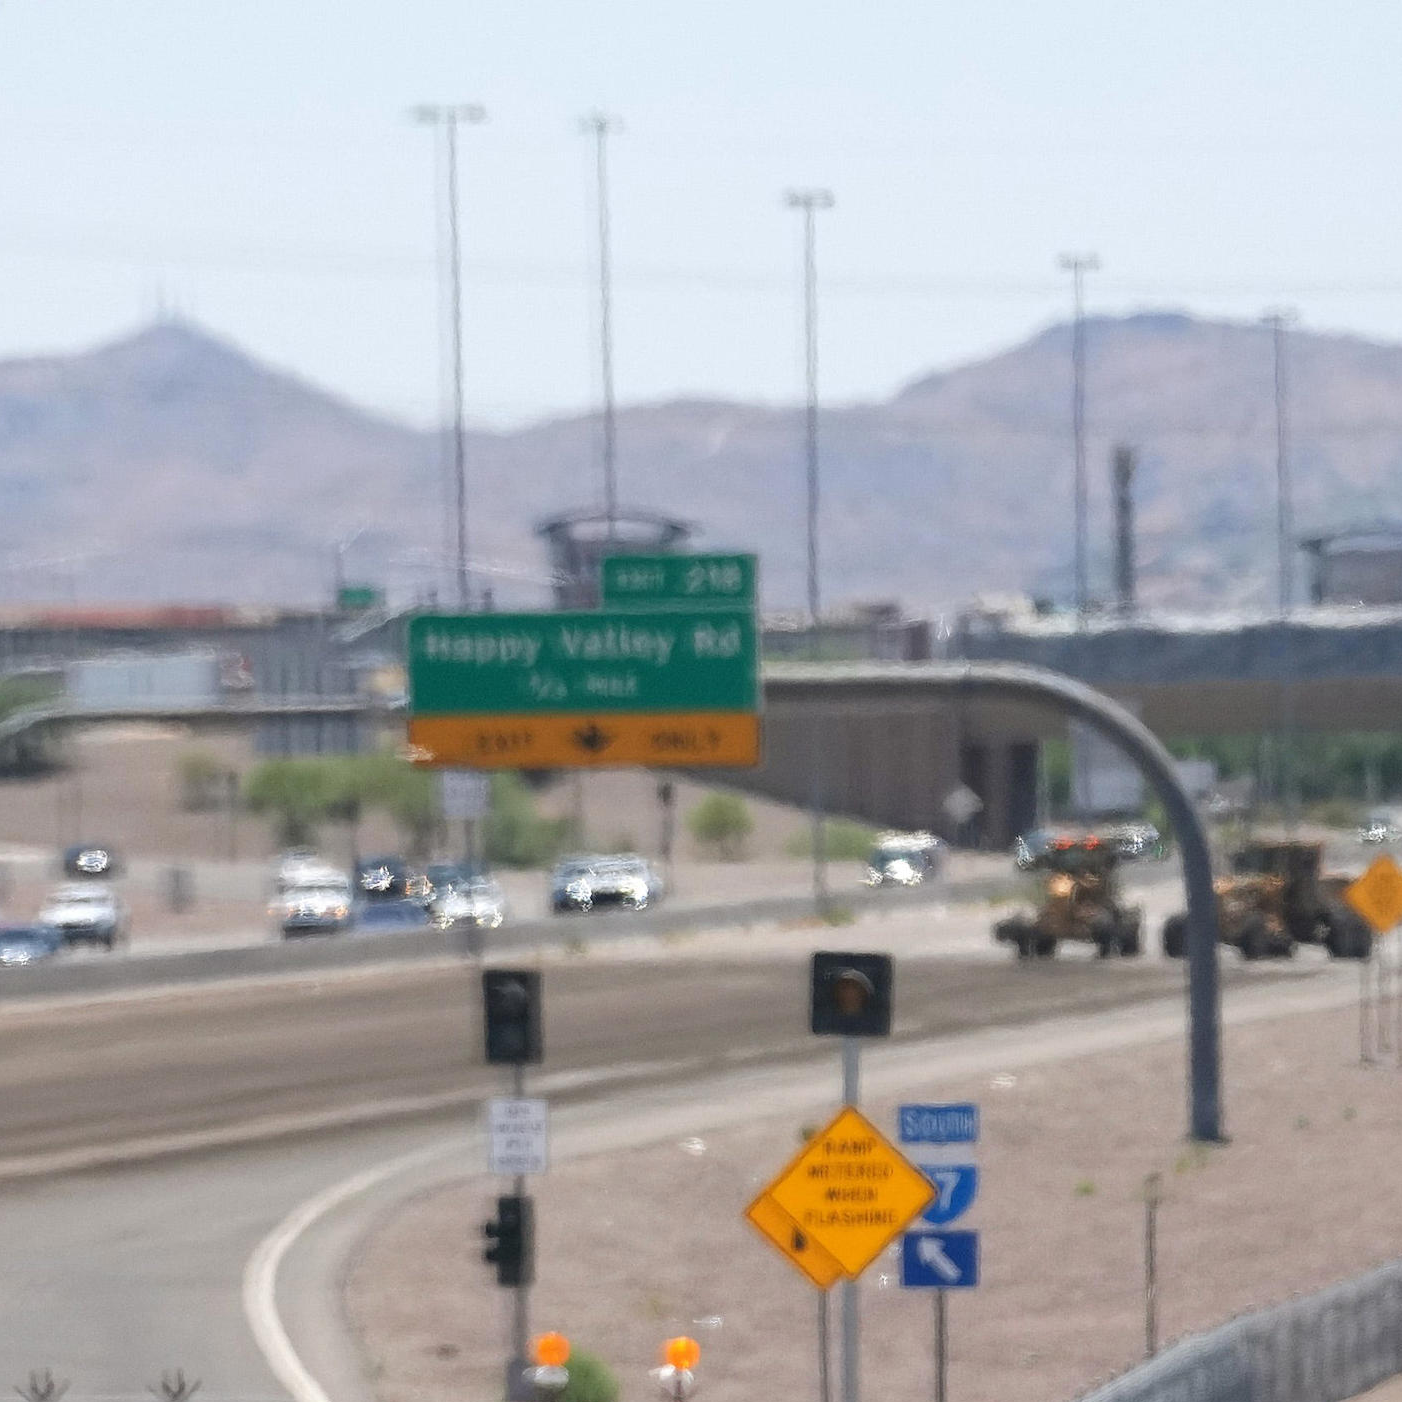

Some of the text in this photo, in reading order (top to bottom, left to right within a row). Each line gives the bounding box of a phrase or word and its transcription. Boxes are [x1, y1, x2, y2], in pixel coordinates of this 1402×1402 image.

[426, 622, 741, 667] Happy Valley Rd
